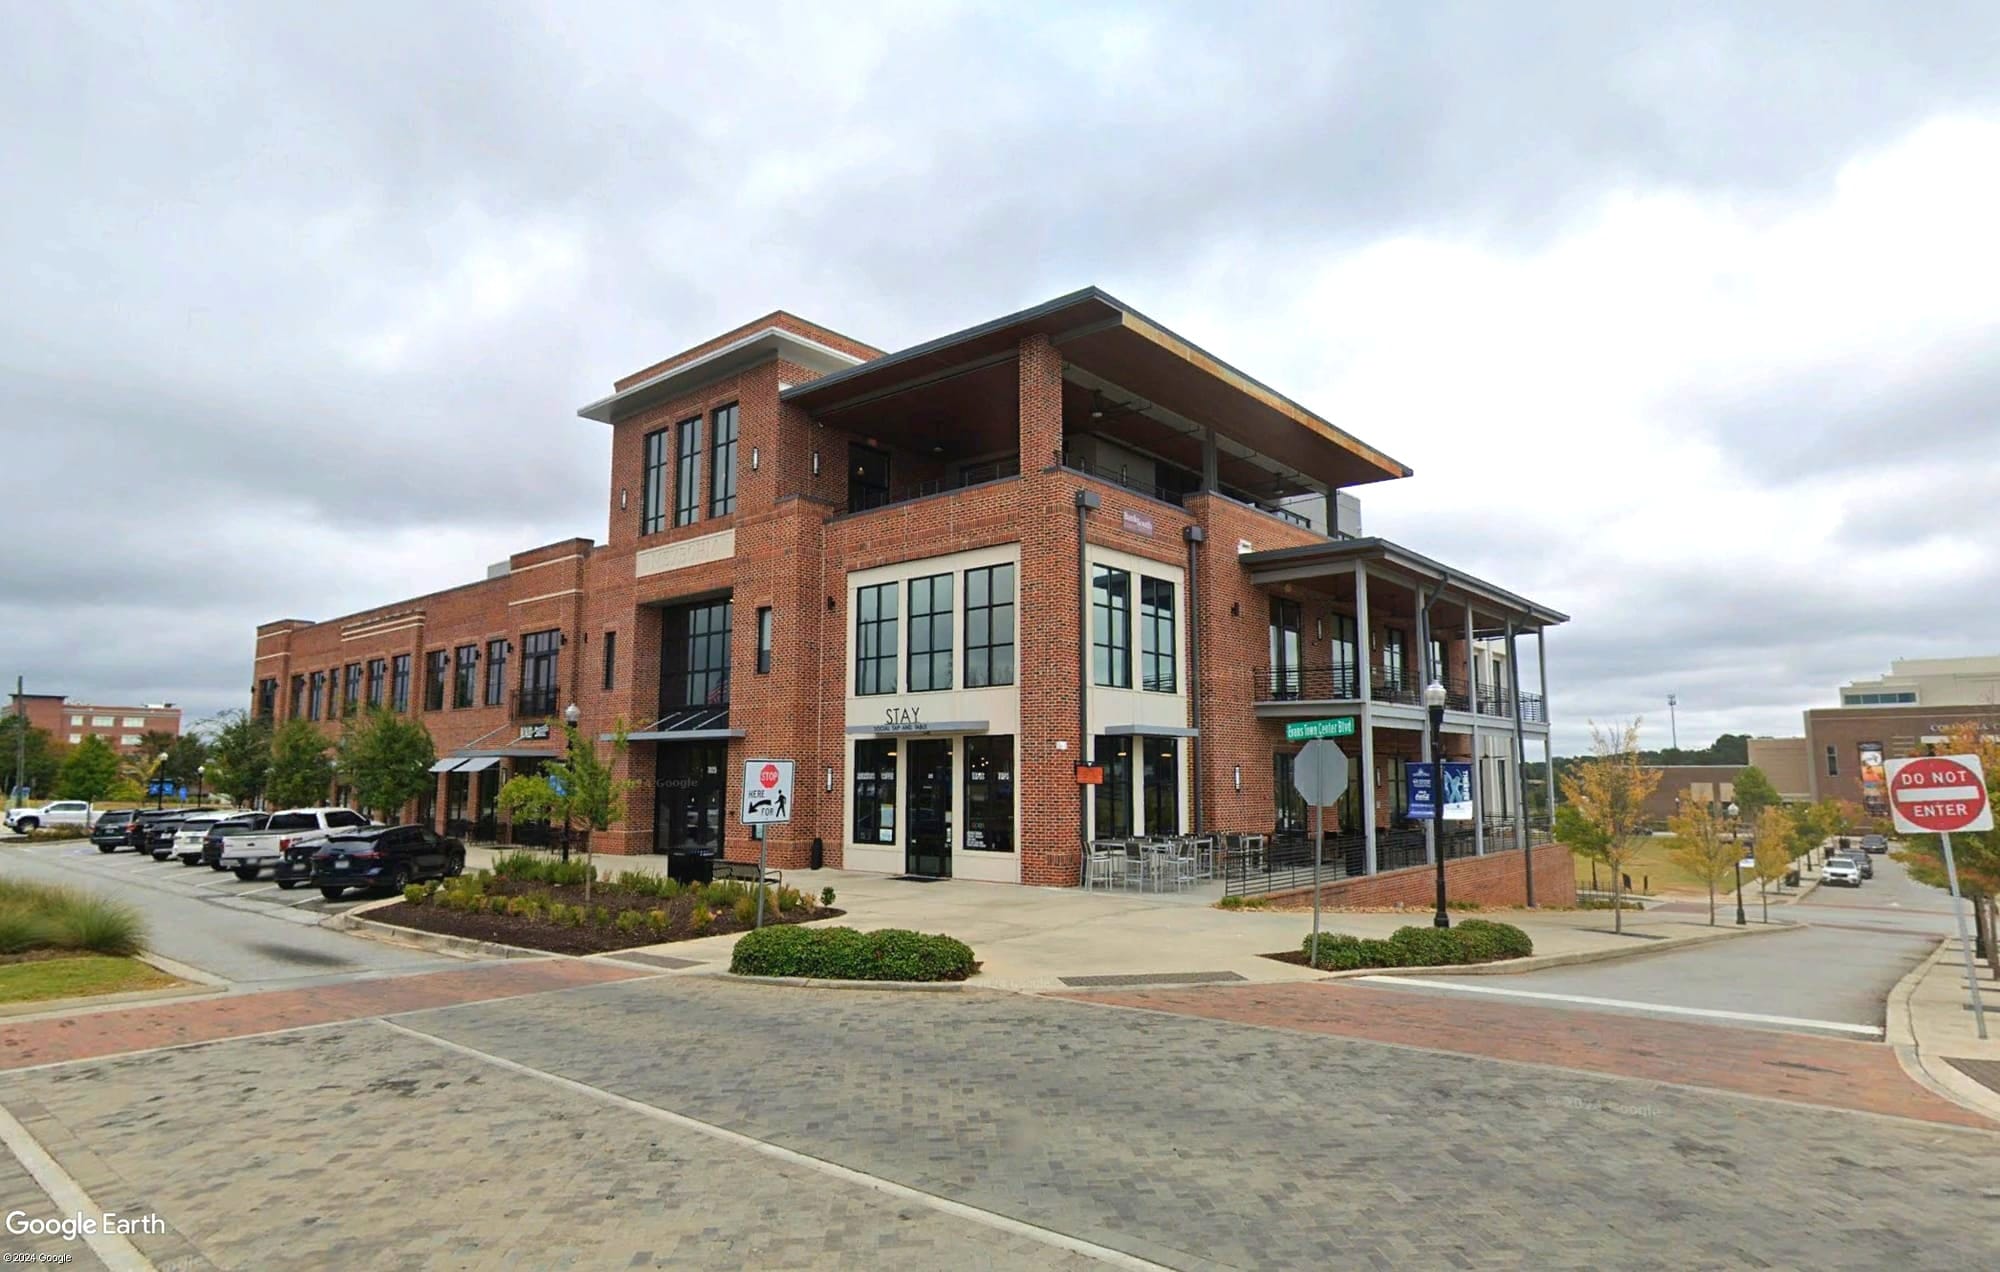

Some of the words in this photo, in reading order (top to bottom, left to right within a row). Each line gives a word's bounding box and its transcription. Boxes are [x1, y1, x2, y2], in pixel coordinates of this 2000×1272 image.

[885, 706, 920, 725] STAY
[1318, 722, 1337, 735] Center
[1337, 720, 1352, 733] Blvd
[761, 772, 778, 781] STOP
[1901, 772, 1925, 785] DO
[1931, 770, 1967, 784] NOT
[749, 790, 765, 798] HERE
[761, 807, 774, 817] FOR
[1913, 803, 1968, 817] ENTER
